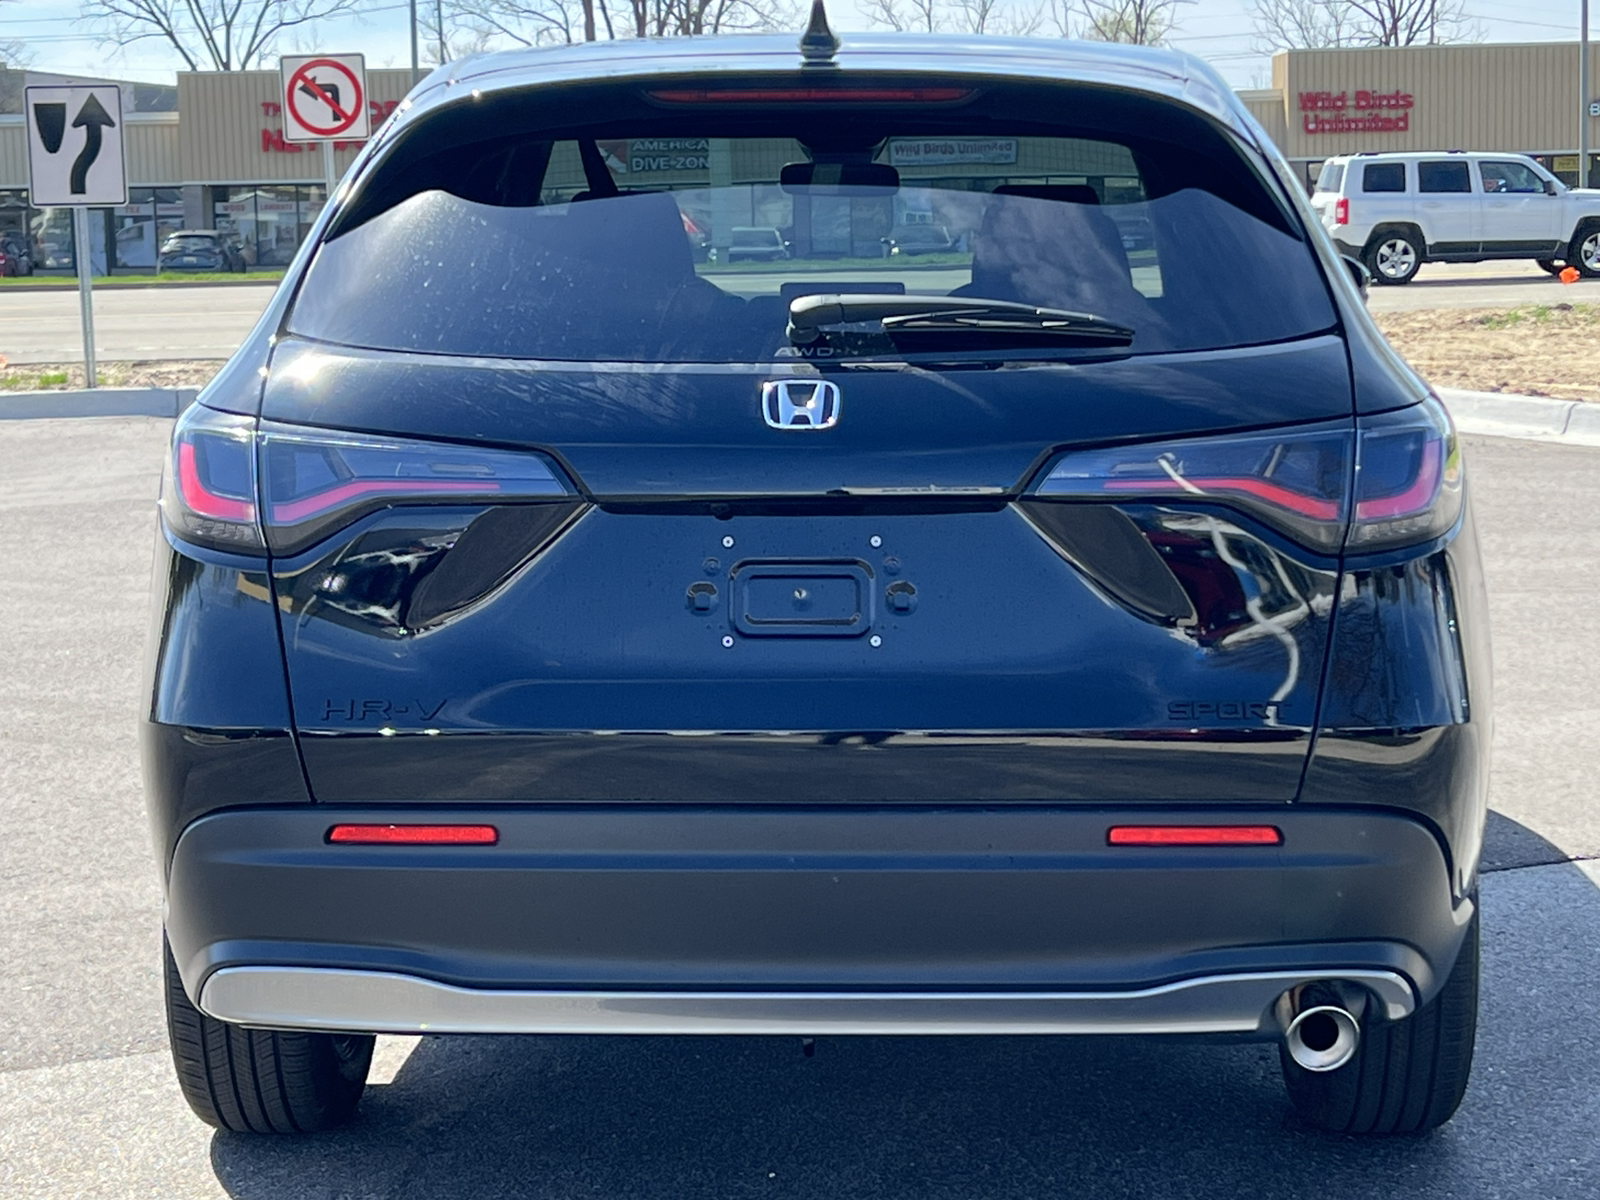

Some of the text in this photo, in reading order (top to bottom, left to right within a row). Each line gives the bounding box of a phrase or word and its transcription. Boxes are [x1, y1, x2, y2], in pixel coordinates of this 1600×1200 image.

[1298, 90, 1414, 111] Wild Birds
[1304, 112, 1409, 134] Unlimited
[632, 140, 710, 151] AMERICA
[894, 141, 1013, 156] Wild Birds Unlimited
[774, 346, 834, 357] AWD
[320, 698, 448, 721] HR-V
[1167, 701, 1293, 720] SPORT
